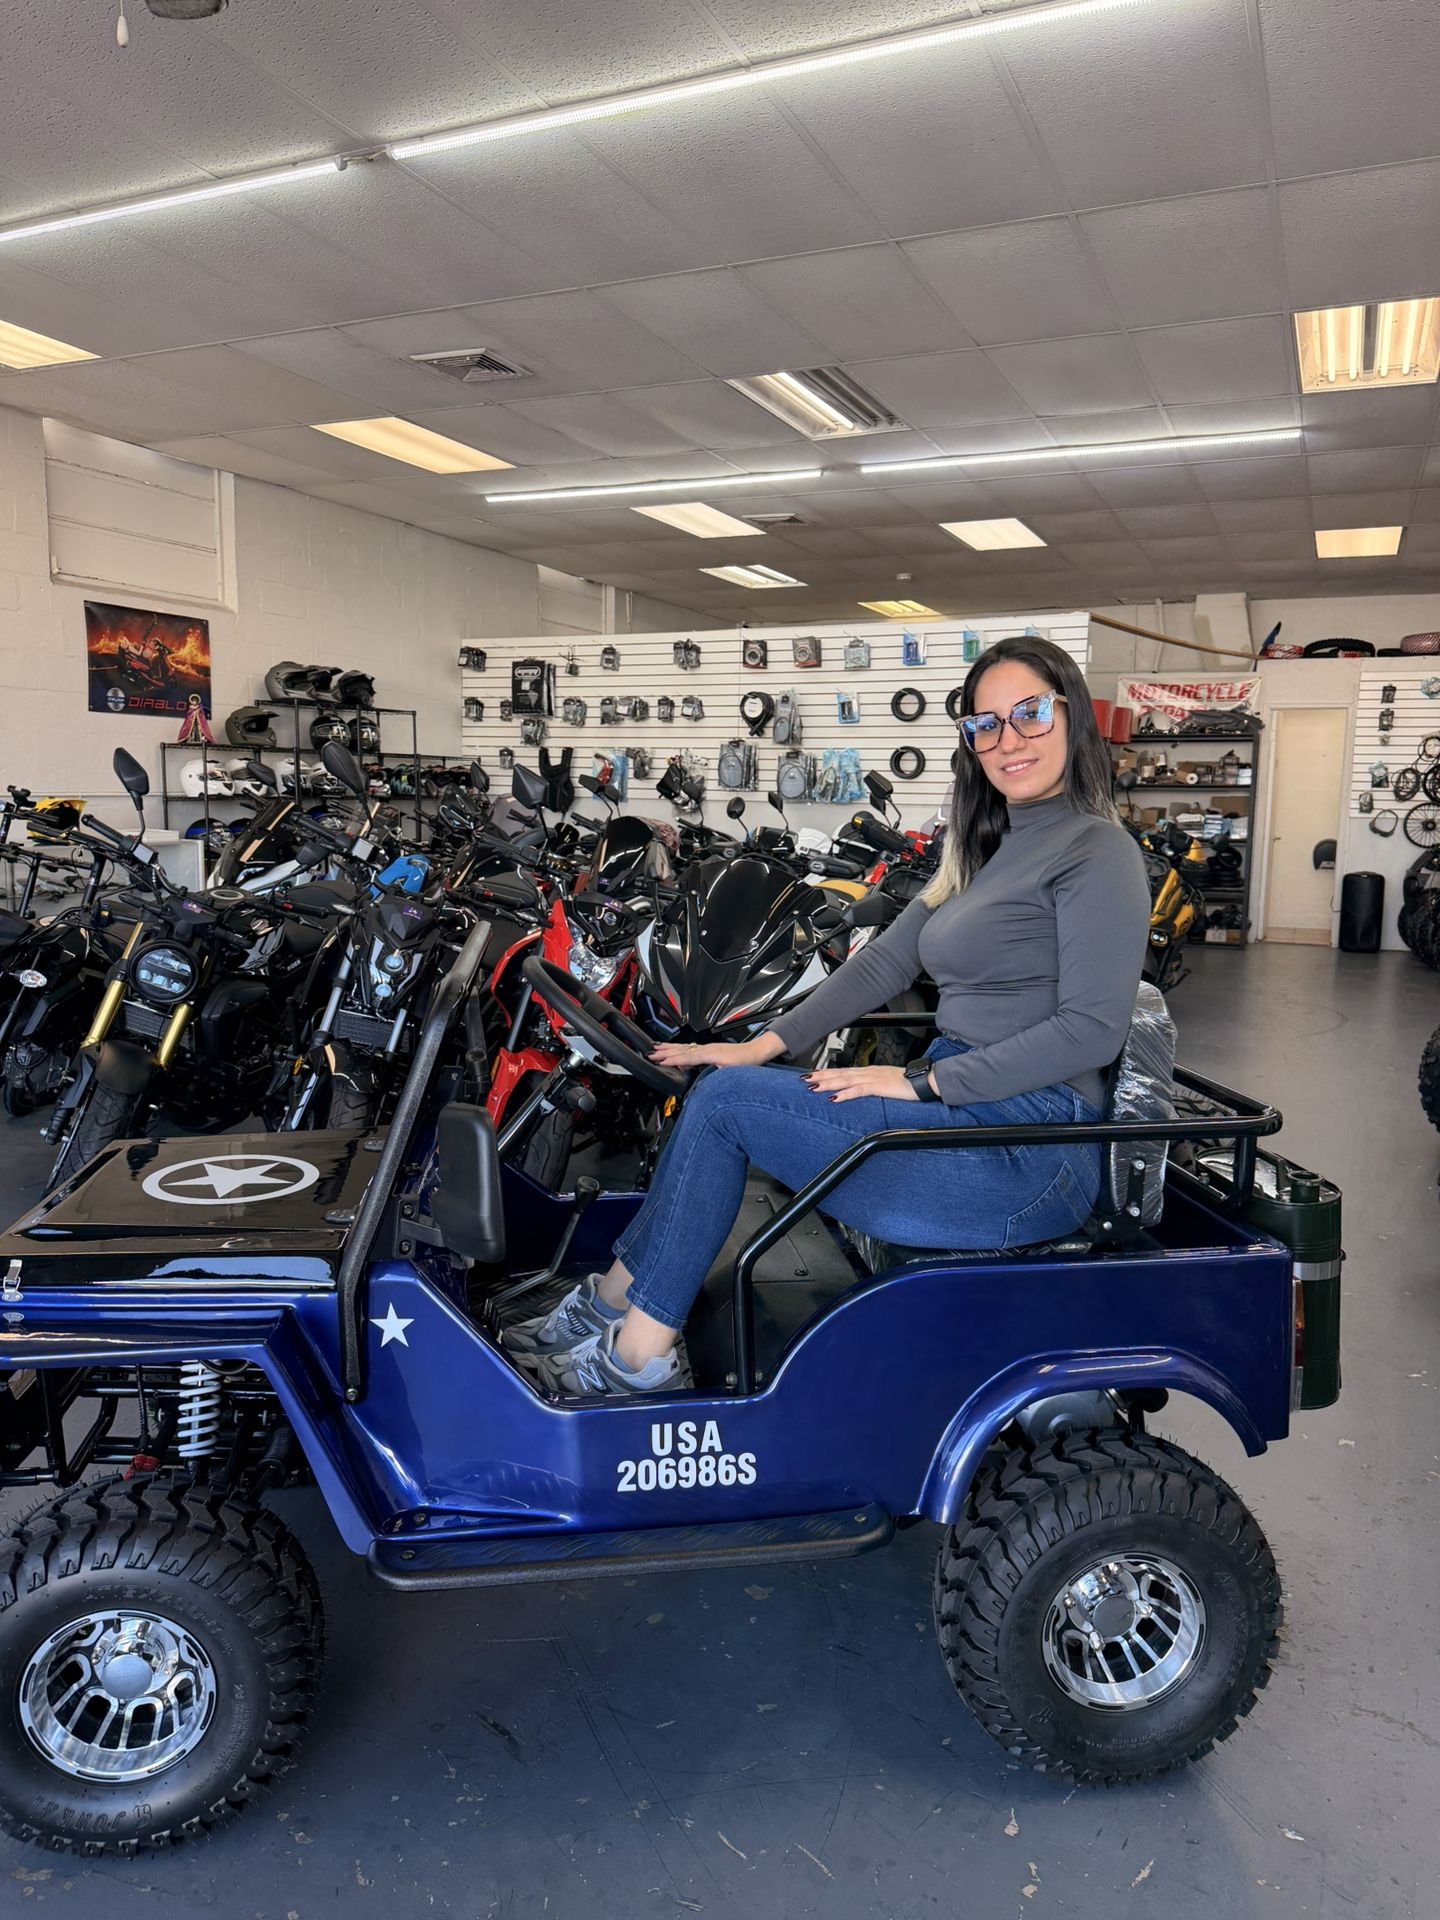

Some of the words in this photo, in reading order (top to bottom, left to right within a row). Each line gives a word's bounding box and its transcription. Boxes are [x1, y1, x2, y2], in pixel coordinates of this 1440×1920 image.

[128, 696, 187, 711] DIABLO
[1127, 682, 1253, 702] MOTORCYCLE
[651, 1420, 723, 1456] USA
[616, 1452, 757, 1492] 206986S
